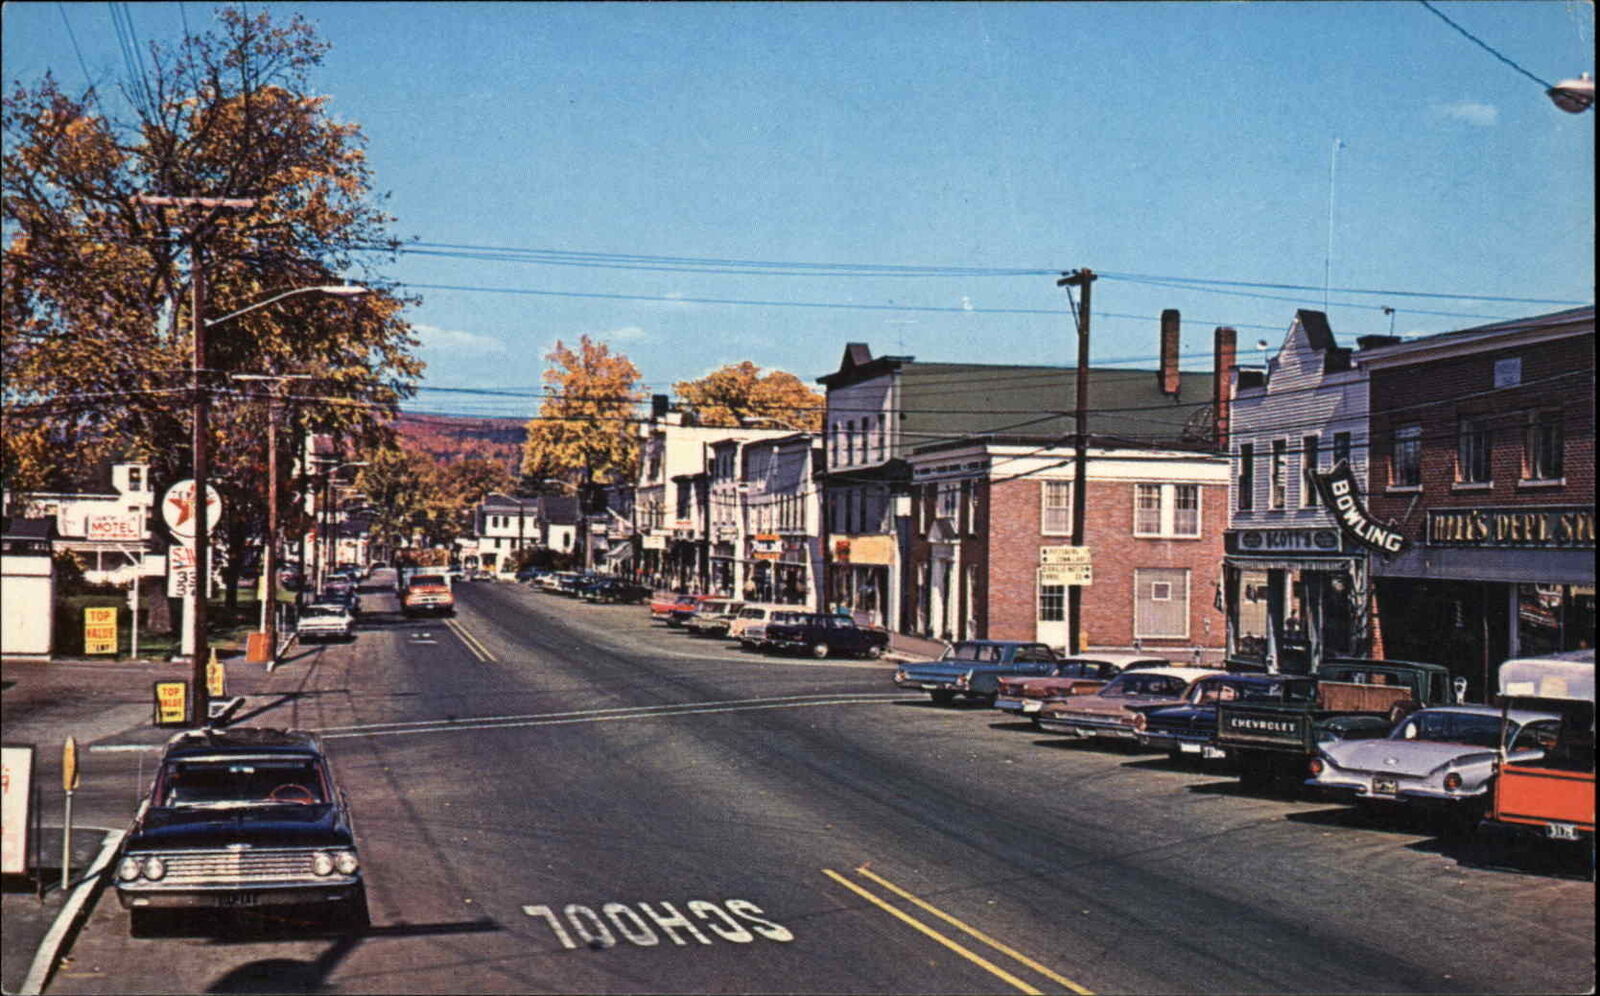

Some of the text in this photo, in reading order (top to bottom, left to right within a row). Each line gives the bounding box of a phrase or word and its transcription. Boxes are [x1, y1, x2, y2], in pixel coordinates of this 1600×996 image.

[1331, 480, 1403, 551] BOWLING
[92, 521, 135, 533] MOTEL
[90, 610, 111, 622] TOP
[87, 628, 114, 639] VALUE
[162, 687, 180, 696] TOP
[1231, 718, 1295, 732] CHEVROLET
[522, 900, 794, 949] SCHOOL
